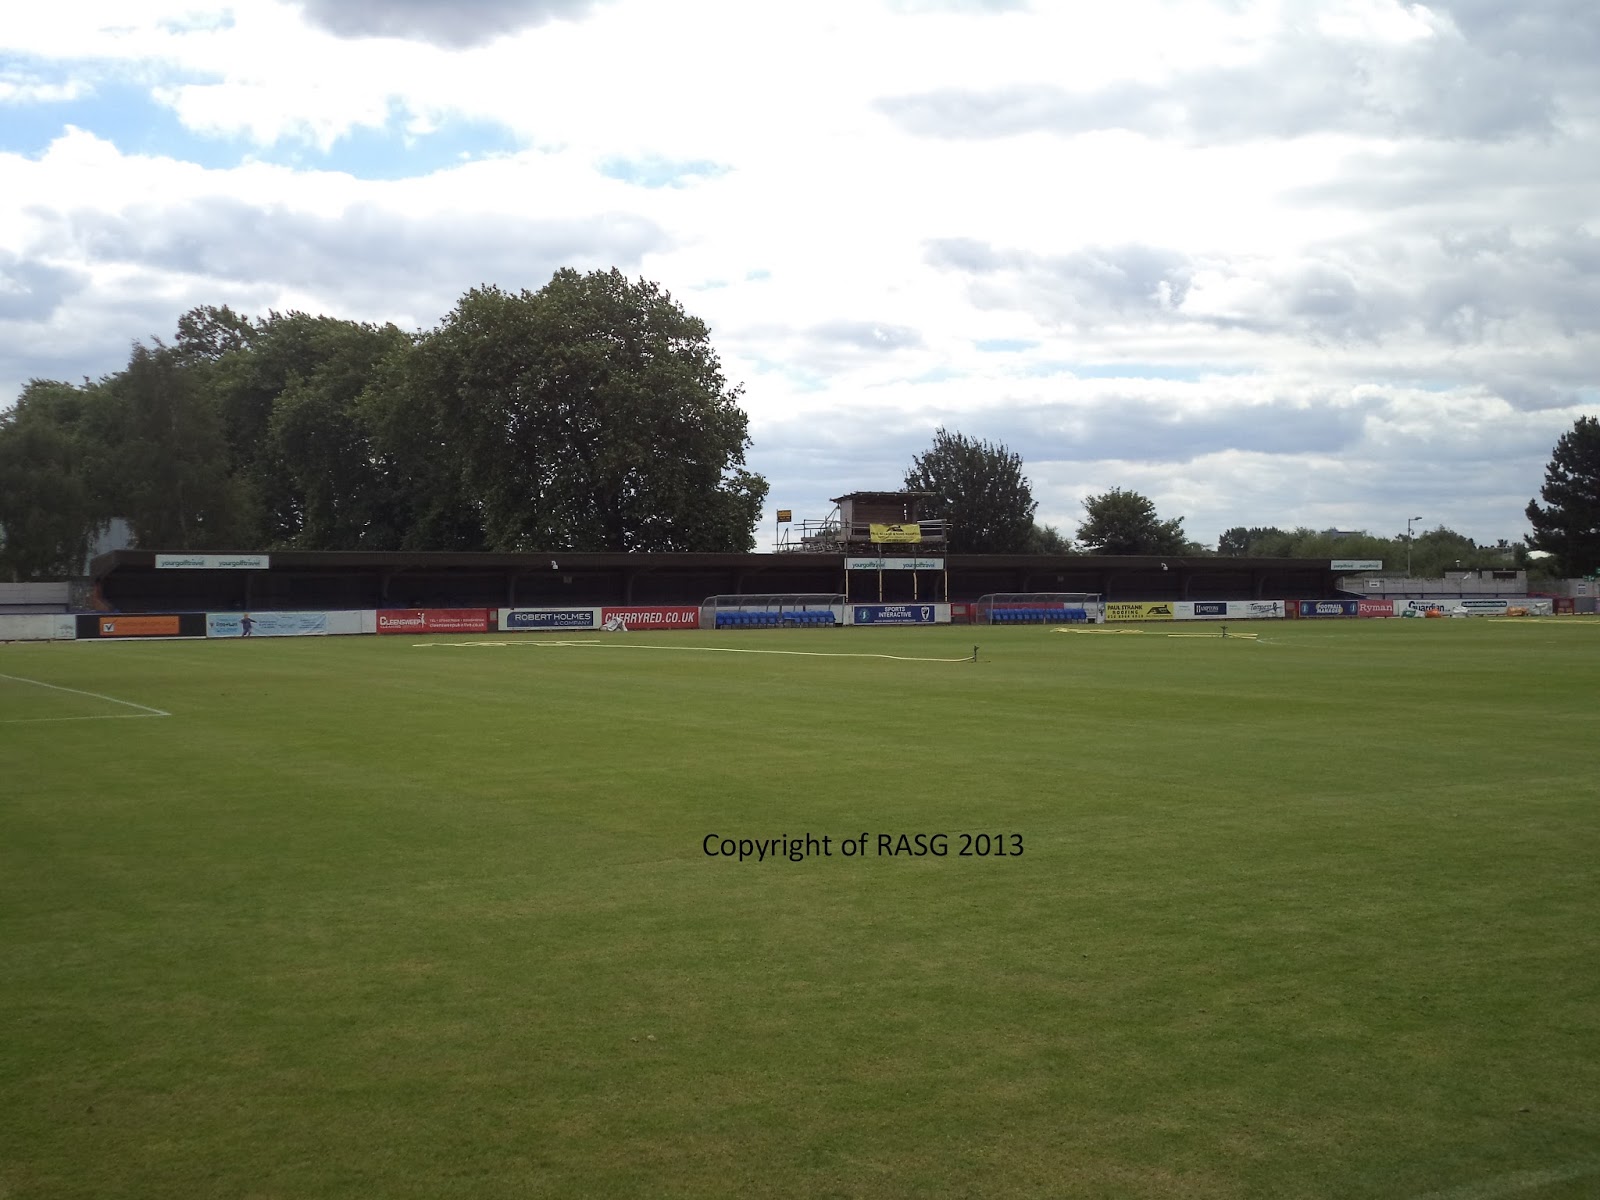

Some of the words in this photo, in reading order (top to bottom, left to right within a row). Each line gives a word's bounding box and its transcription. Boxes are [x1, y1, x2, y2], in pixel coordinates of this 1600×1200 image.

[1359, 603, 1393, 613] Ryman
[1408, 600, 1445, 612] Guardian
[514, 613, 552, 621] ROBERT
[553, 613, 591, 621] HOLMES
[605, 612, 696, 624] CHERRYRED.CO.UK
